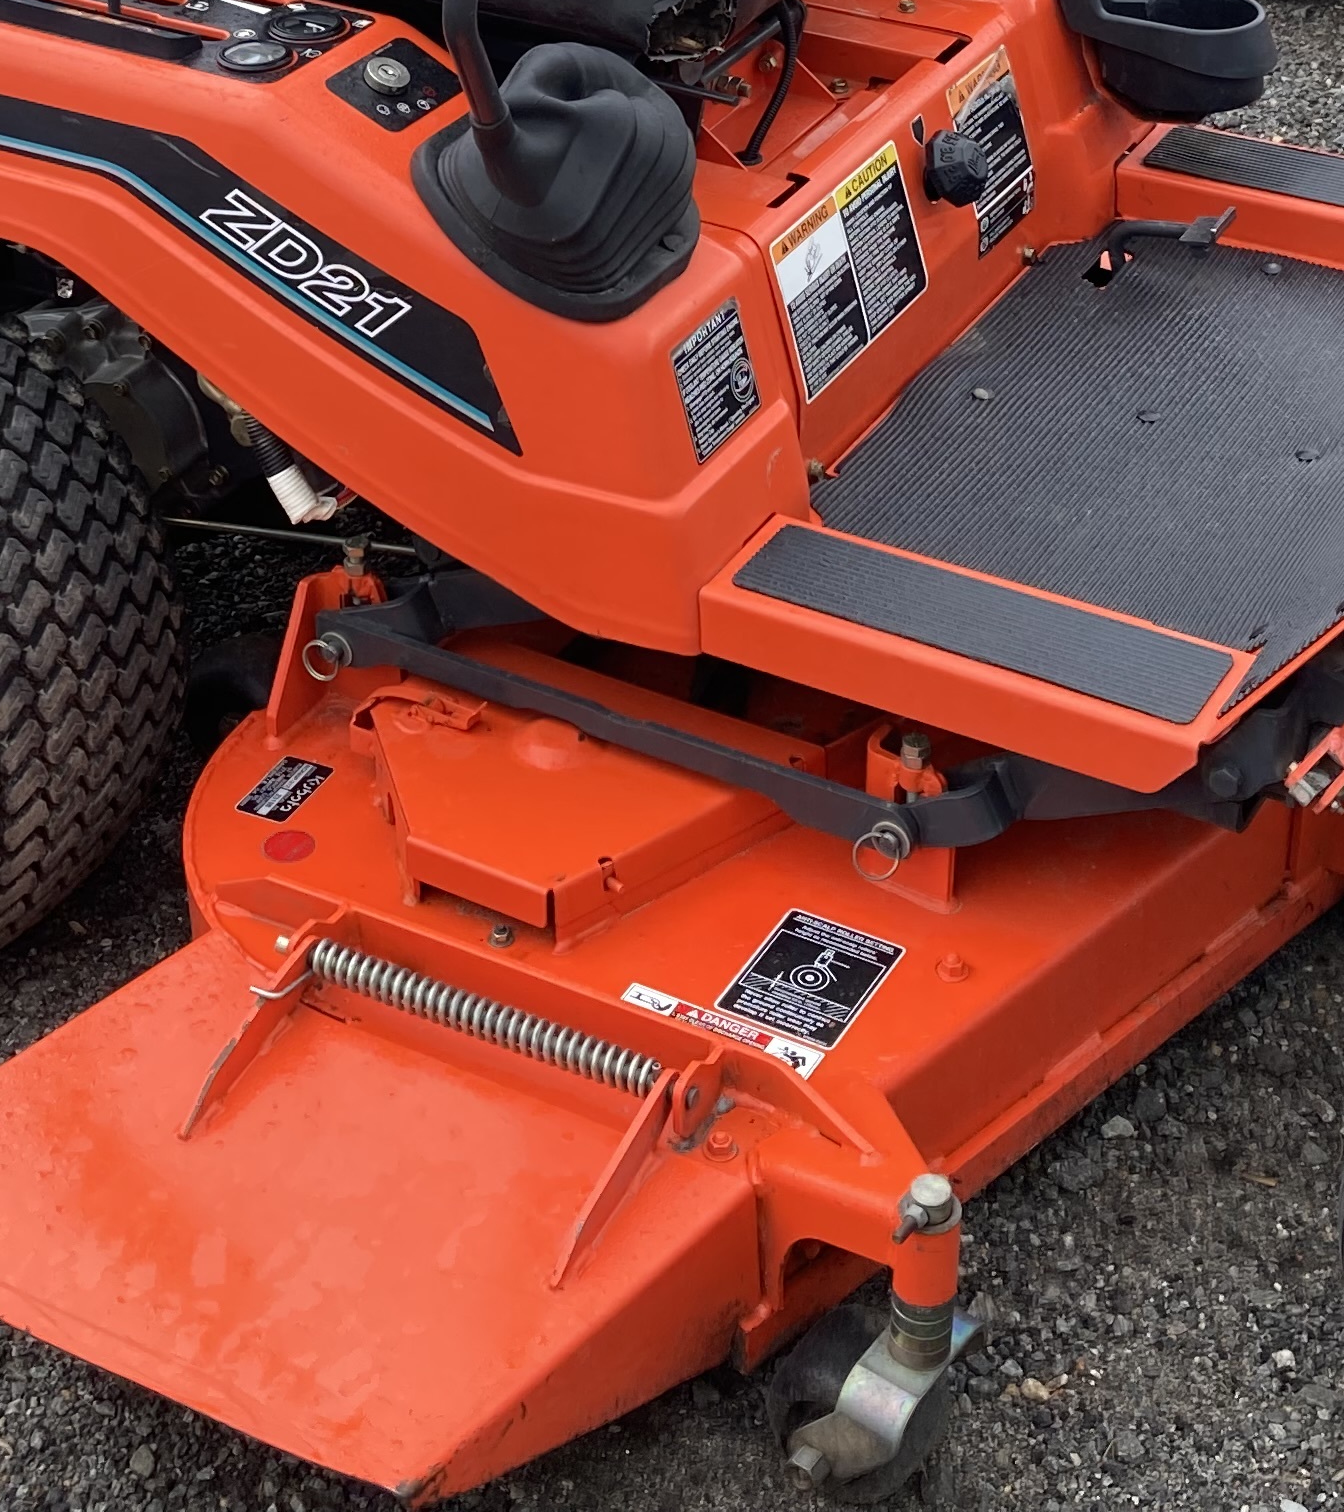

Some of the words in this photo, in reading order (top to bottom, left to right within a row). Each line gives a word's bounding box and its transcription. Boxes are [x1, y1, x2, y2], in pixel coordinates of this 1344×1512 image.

[851, 152, 889, 192] CAUTION
[787, 204, 829, 247] WARNING
[199, 188, 412, 338] ZD21
[683, 311, 726, 355] IMPORTANT
[279, 774, 325, 812] Kubota
[700, 1010, 759, 1041] DANGER
